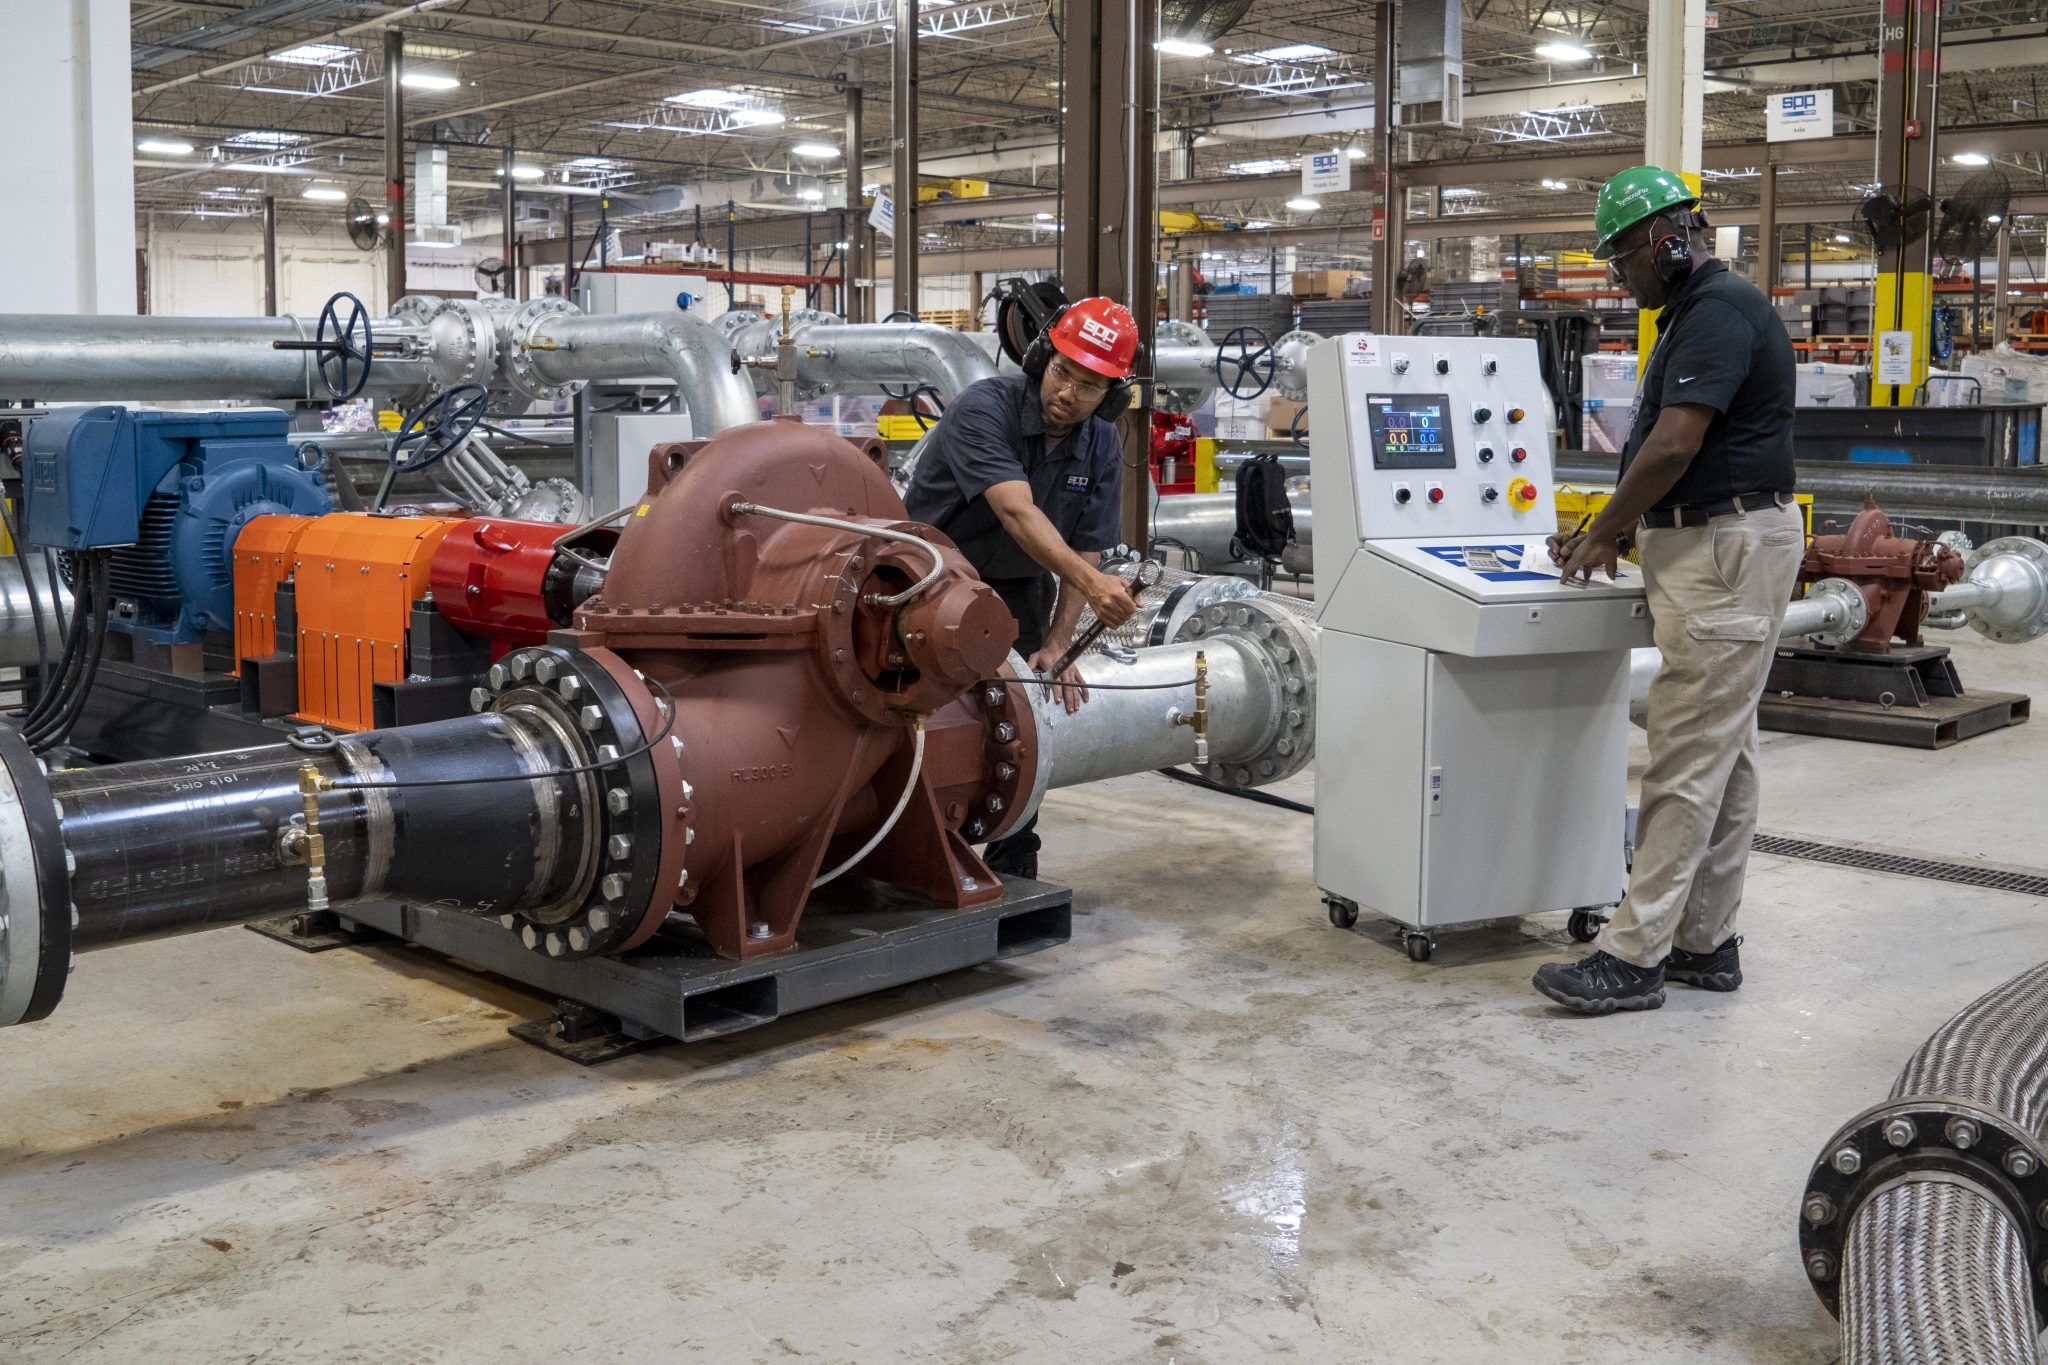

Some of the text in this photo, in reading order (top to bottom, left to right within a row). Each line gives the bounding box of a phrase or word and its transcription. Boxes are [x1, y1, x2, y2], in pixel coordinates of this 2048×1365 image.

[1886, 26, 1904, 41] H6
[1782, 94, 1816, 110] spp
[1313, 154, 1338, 168] spp
[1616, 187, 1649, 206] SyncroFlo
[1082, 318, 1118, 344] spp
[1389, 433, 1408, 444] 0.0
[1420, 433, 1435, 443] 0.0
